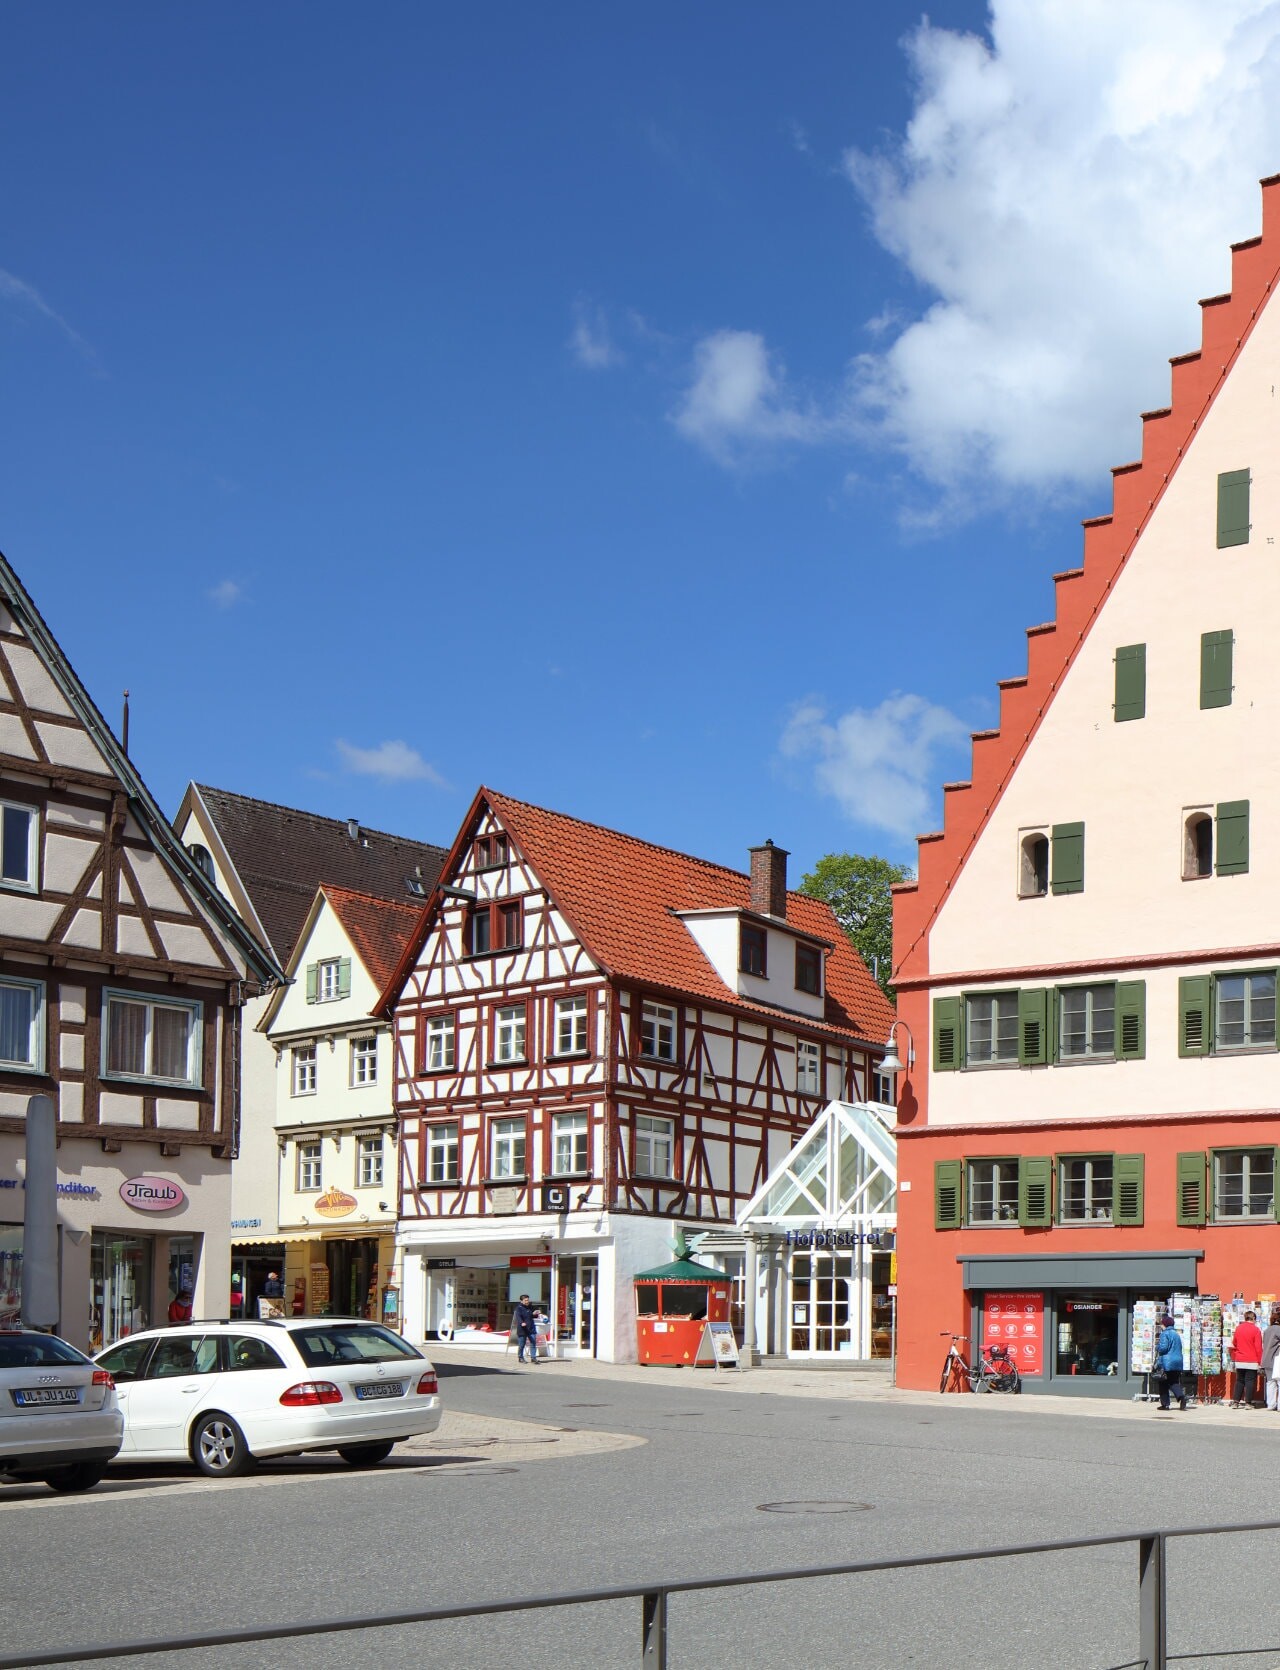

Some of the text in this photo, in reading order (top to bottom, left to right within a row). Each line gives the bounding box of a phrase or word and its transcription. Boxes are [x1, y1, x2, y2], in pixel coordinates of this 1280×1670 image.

[56, 1181, 96, 1195] nditor
[127, 1183, 177, 1200] Traub
[786, 1228, 881, 1248] Hofpfisterei
[23, 1390, 38, 1401] UL
[361, 1387, 373, 1397] BC
